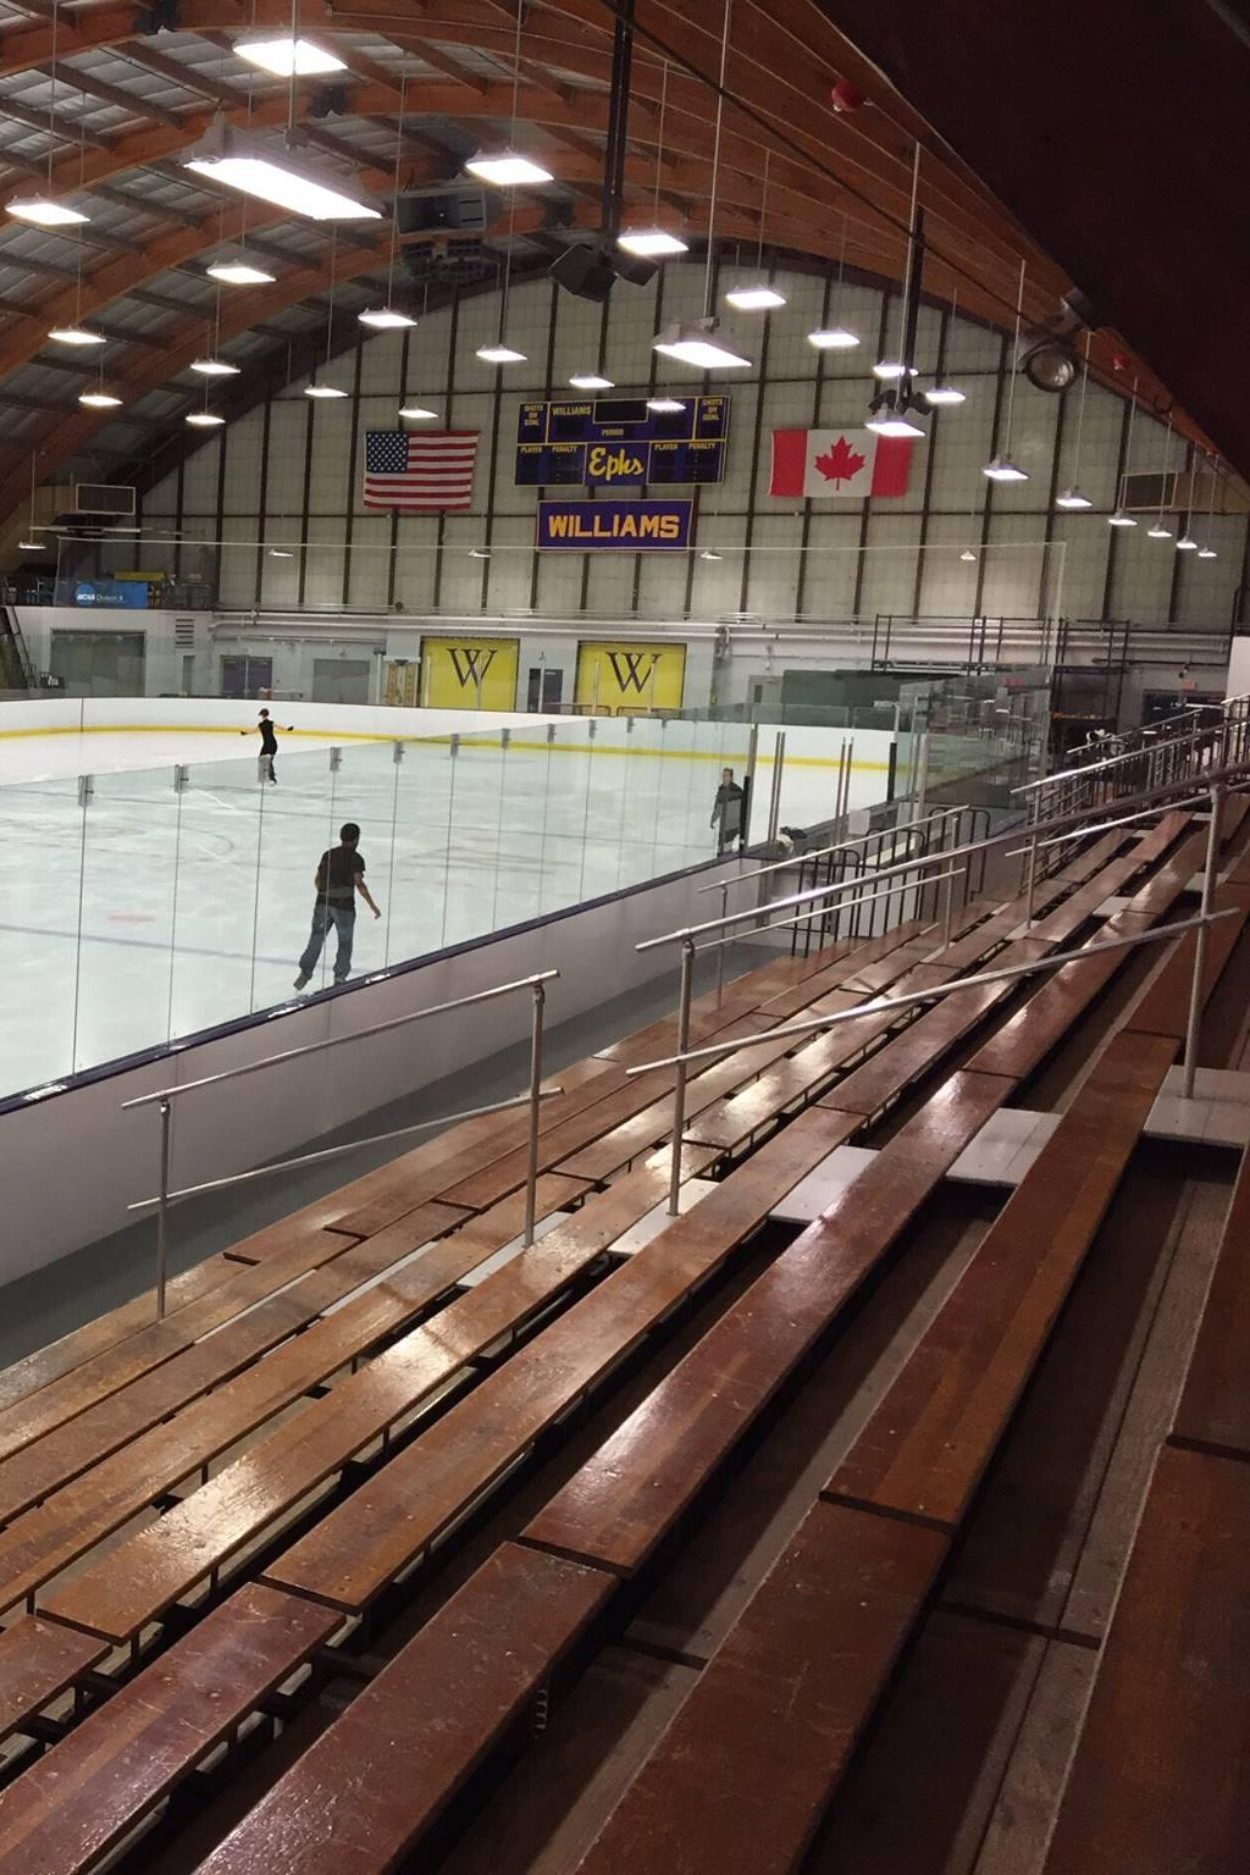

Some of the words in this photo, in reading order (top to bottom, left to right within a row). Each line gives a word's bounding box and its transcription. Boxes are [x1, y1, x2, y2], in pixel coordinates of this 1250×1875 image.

[552, 406, 592, 416] WILLIAMS
[589, 447, 644, 481] Ephs
[548, 514, 680, 538] WILLIAMS
[447, 648, 497, 689] W
[606, 651, 662, 694] W
